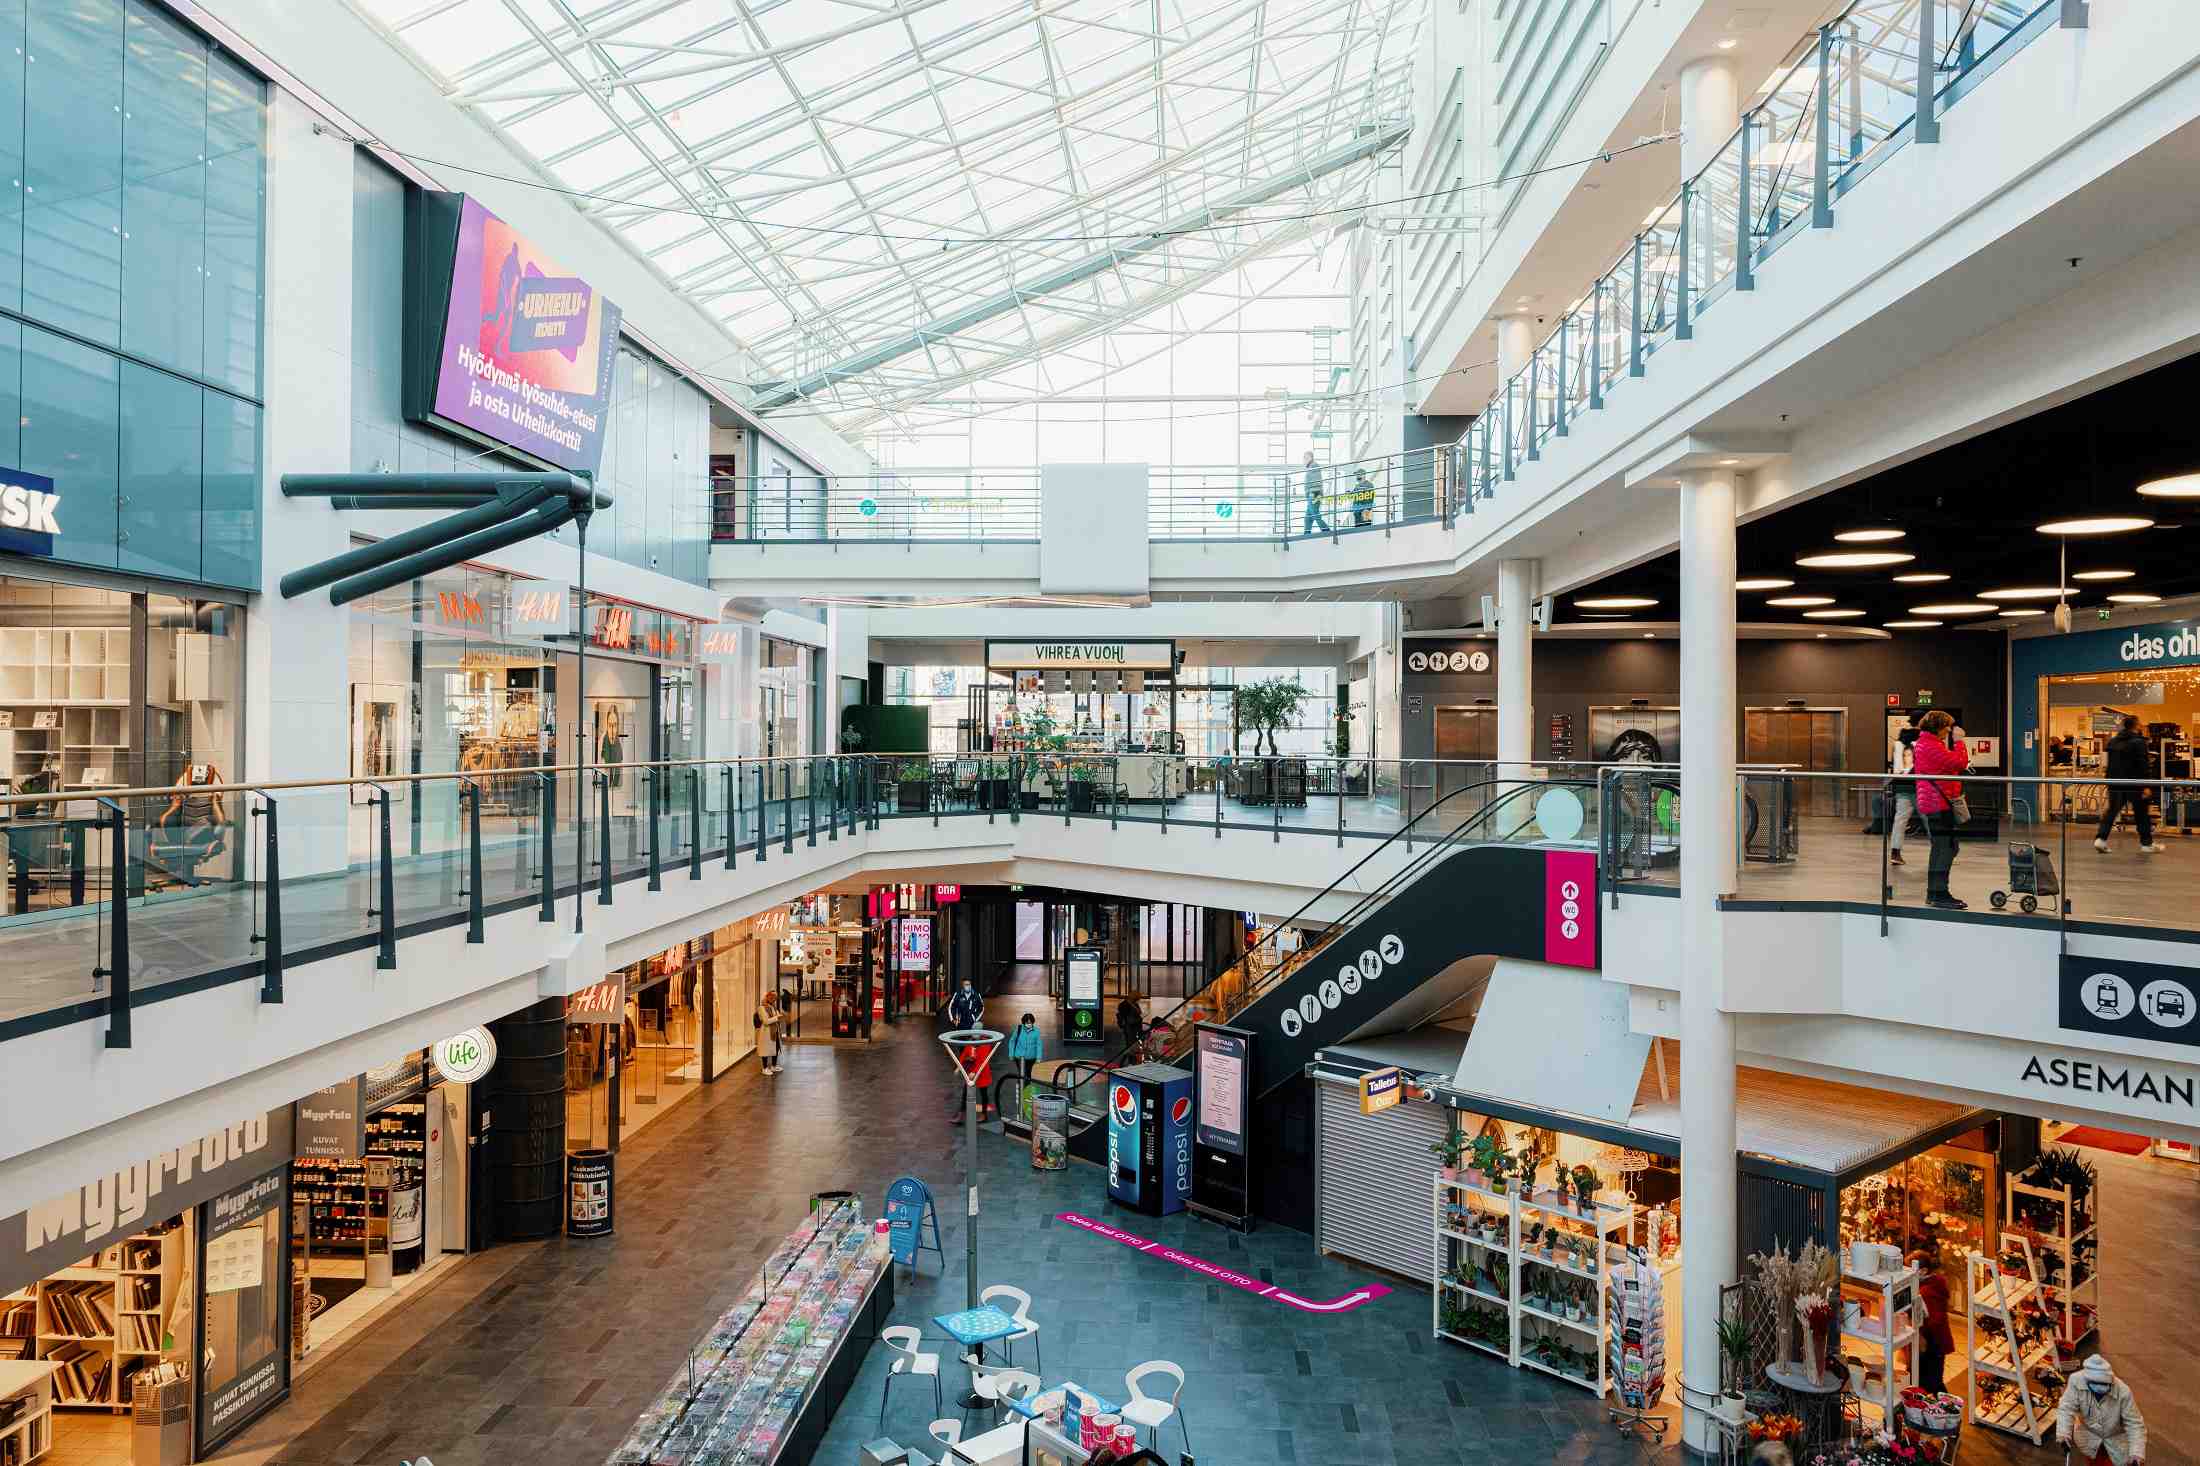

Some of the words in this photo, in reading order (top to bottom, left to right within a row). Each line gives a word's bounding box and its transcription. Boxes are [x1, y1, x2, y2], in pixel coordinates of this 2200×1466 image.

[523, 292, 583, 319] URHEILU
[458, 344, 520, 393] Hyödynnä
[468, 381, 483, 408] ja
[484, 391, 510, 420] osta
[2121, 632, 2165, 661] clas
[938, 885, 956, 895] DNA
[903, 951, 930, 960] HIMO
[577, 984, 618, 1014] H&M
[450, 1040, 479, 1065] life
[1108, 1130, 1120, 1189] pepsi
[1174, 1131, 1191, 1192] pepsi
[1114, 1233, 1143, 1245] OTTO
[1220, 1272, 1251, 1285] OTTO
[213, 1386, 239, 1412] KUVAT
[240, 1361, 275, 1393] TUNNISSA
[259, 1375, 276, 1393] HETI
